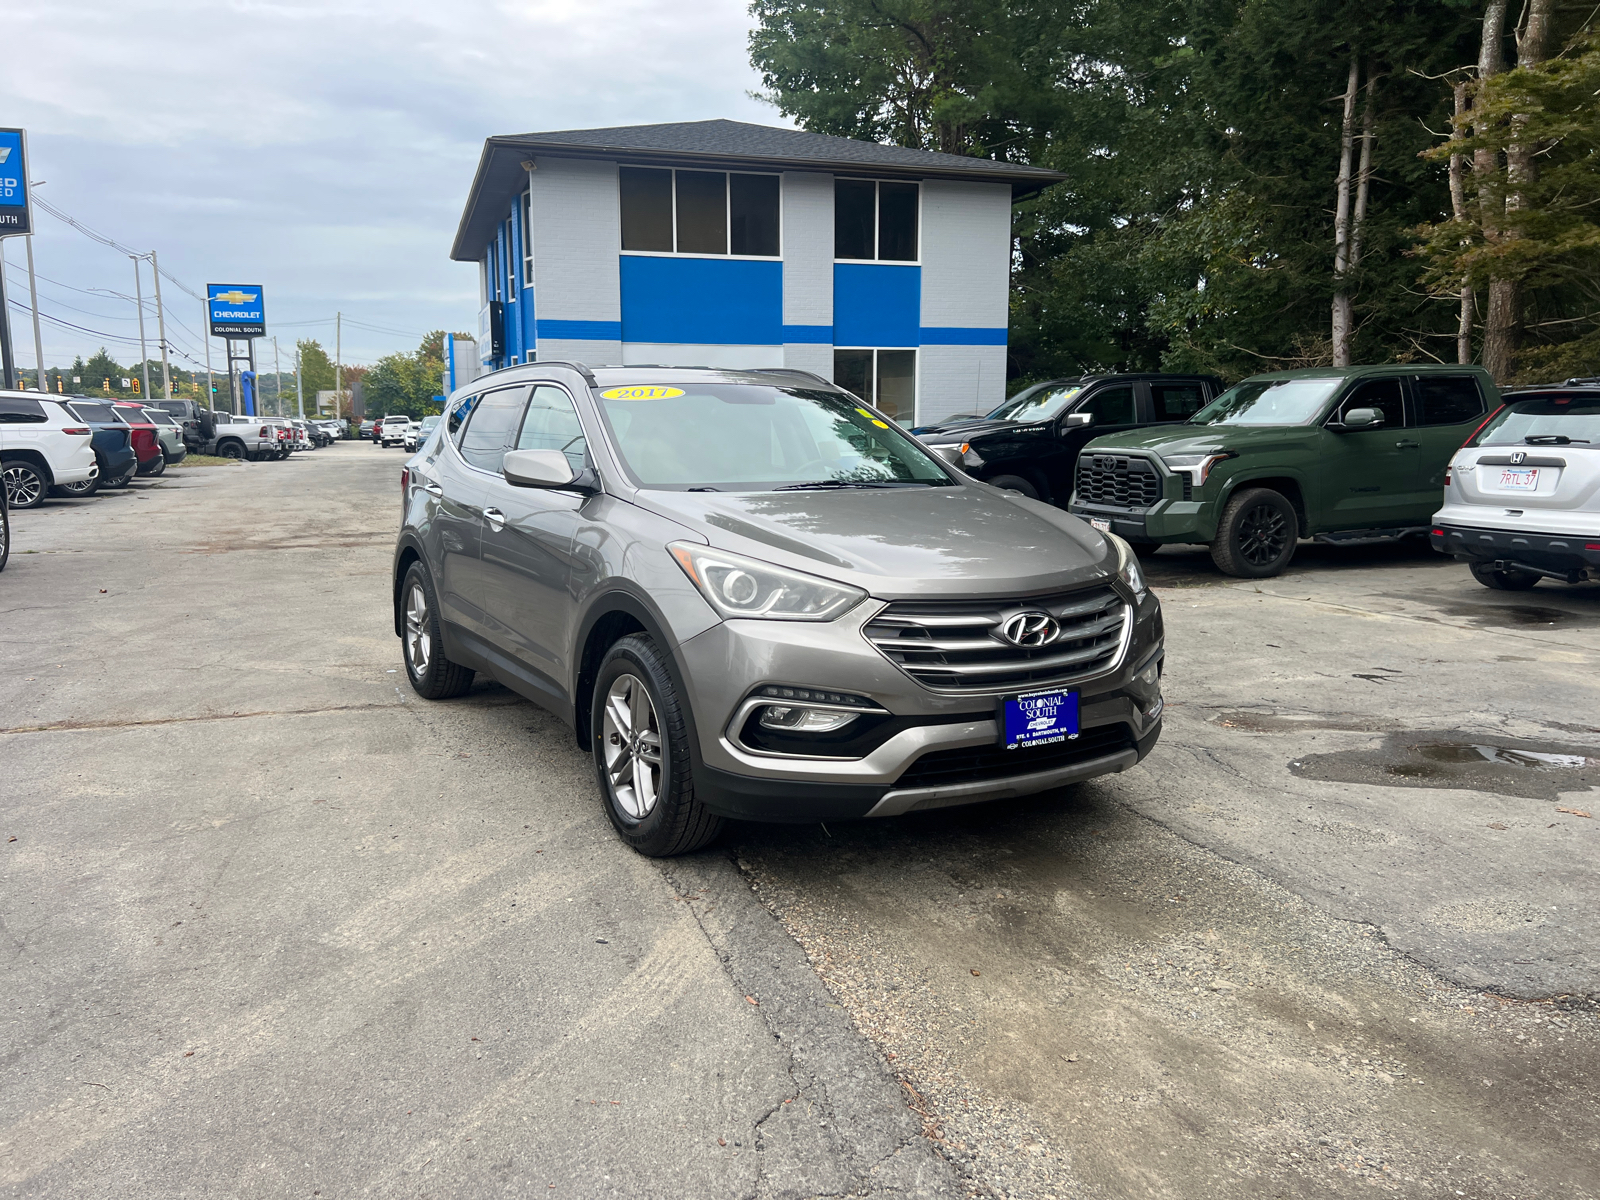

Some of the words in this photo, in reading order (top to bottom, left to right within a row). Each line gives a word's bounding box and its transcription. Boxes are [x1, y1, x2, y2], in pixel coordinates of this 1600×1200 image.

[617, 388, 668, 399] 2017
[1500, 473, 1521, 485] 7RTL
[1524, 474, 1536, 486] 37
[1019, 696, 1064, 711] COLONIAL
[1026, 706, 1057, 719] SOUTH
